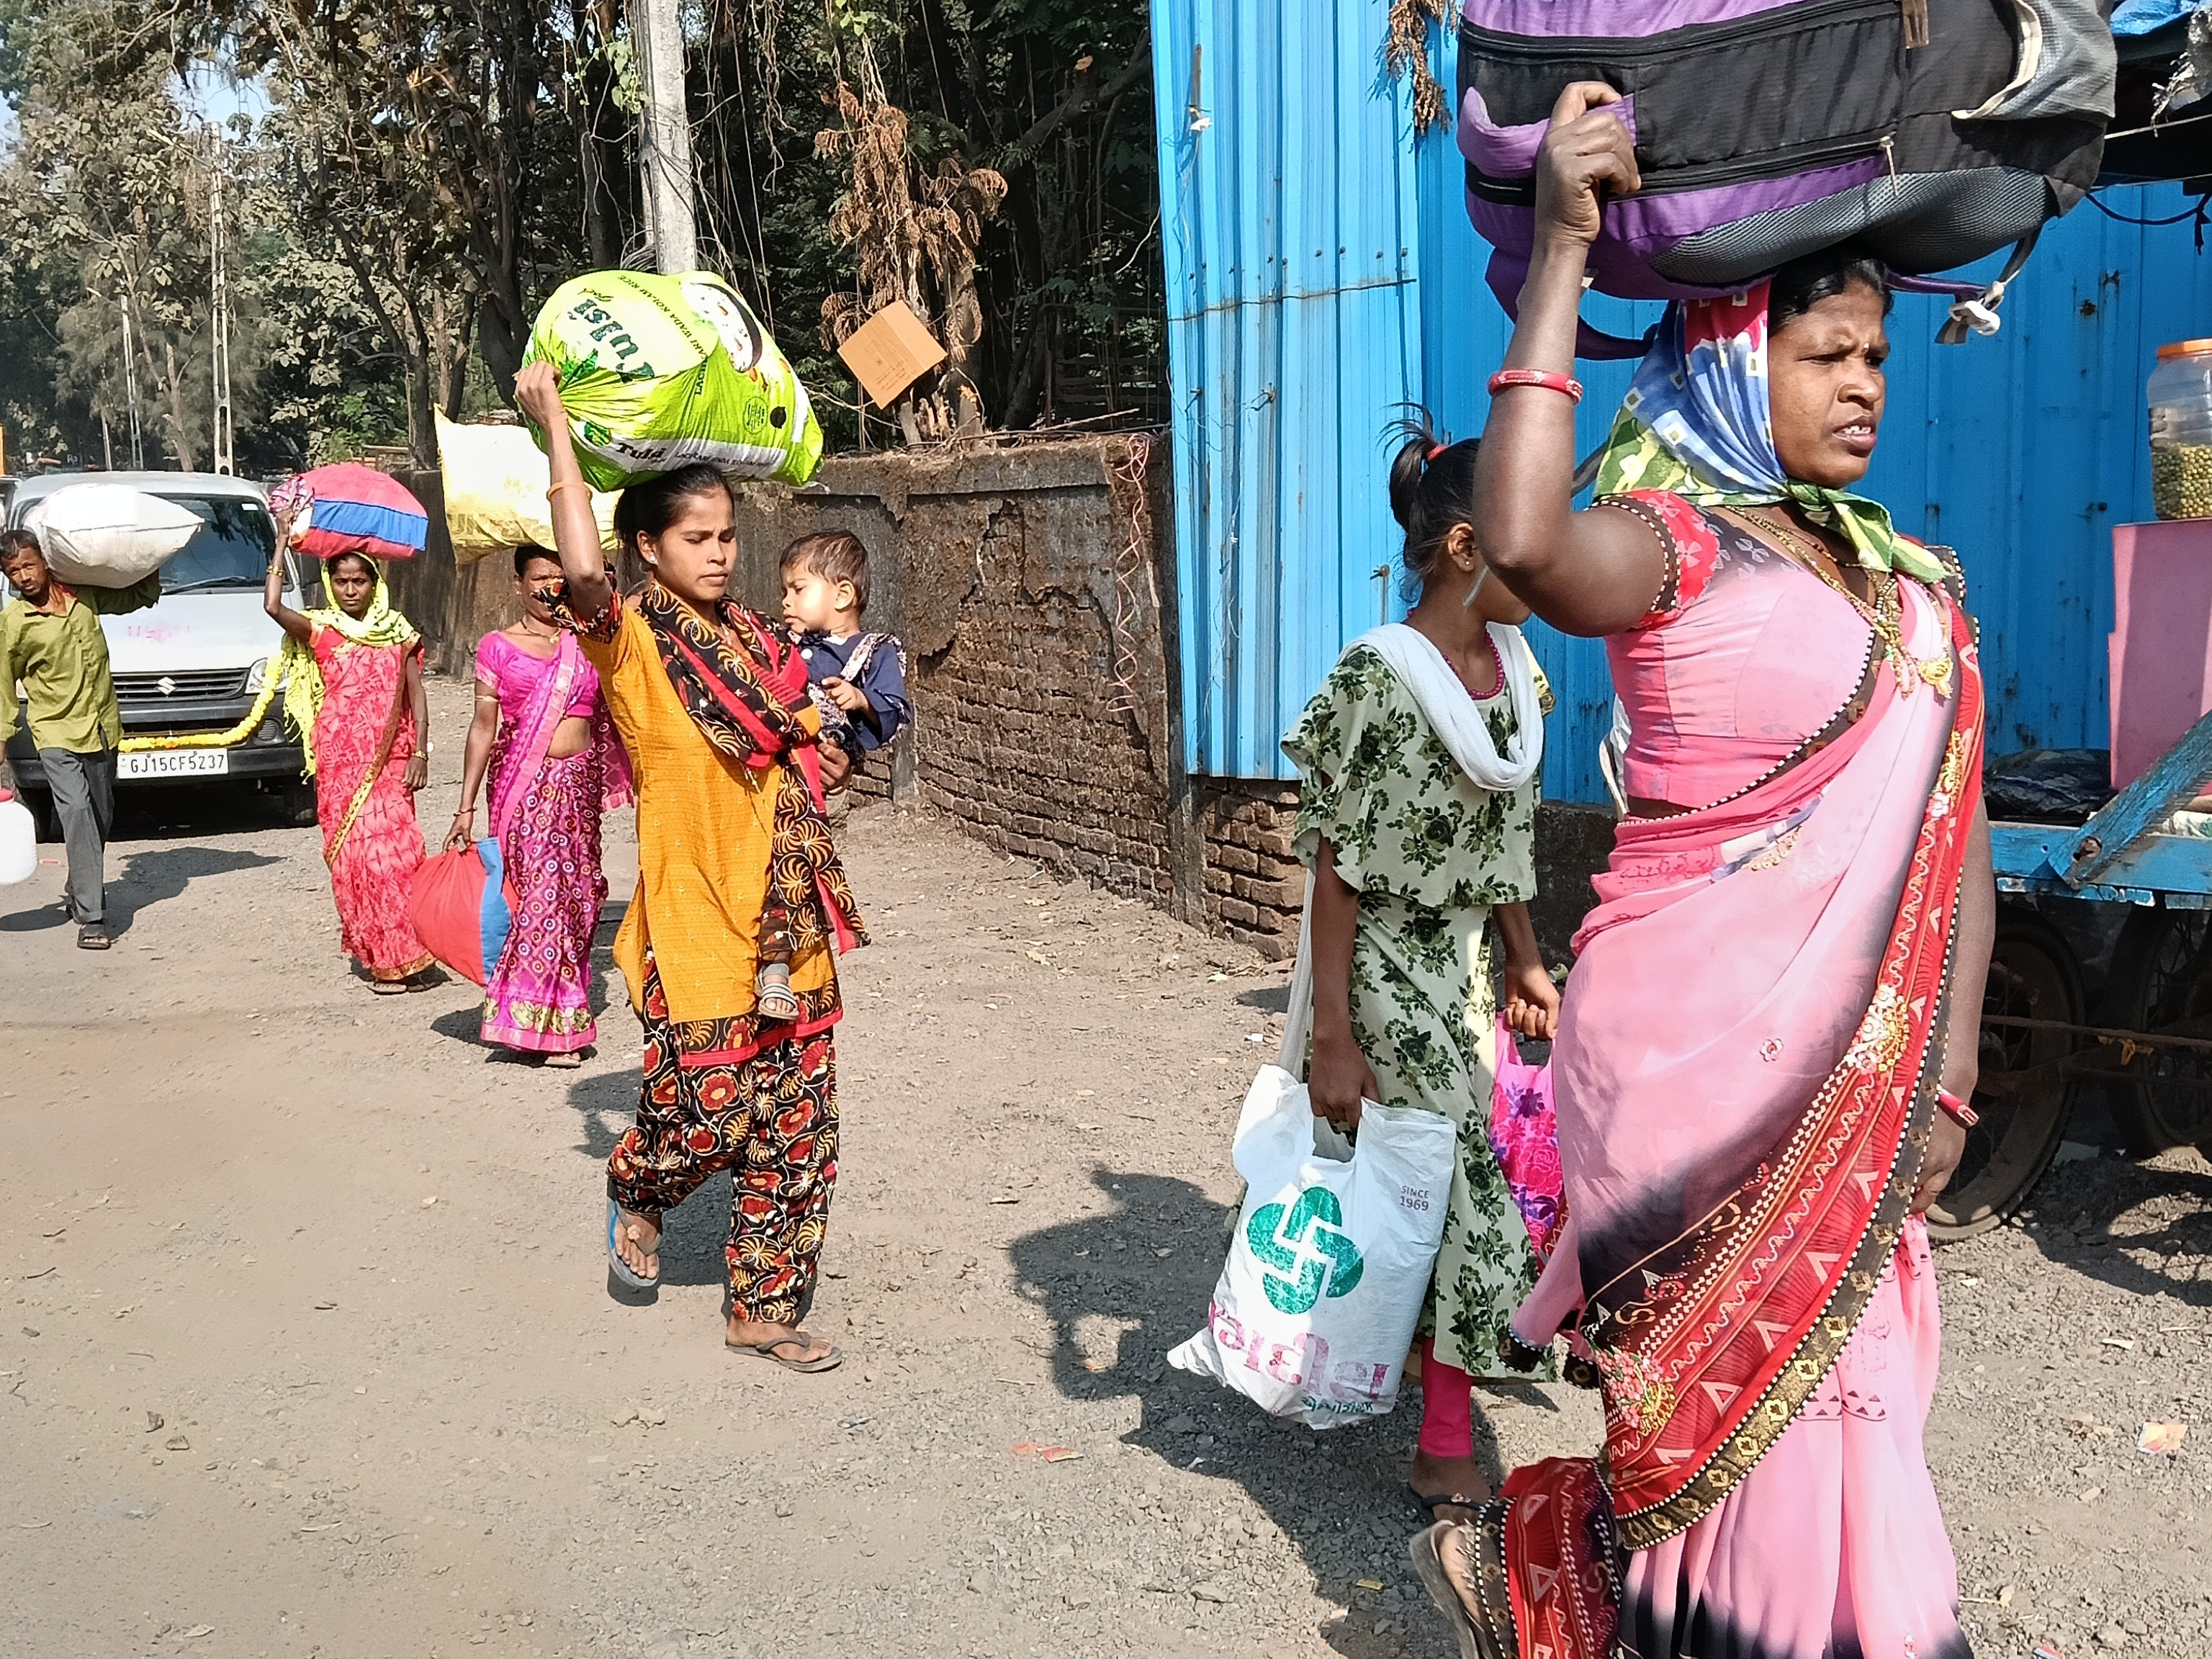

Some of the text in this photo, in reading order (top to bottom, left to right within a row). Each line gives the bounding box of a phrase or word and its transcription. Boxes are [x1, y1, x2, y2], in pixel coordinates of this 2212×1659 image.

[617, 275, 640, 289] RICE
[639, 289, 670, 313] KOLAM
[670, 313, 692, 338] WADA
[567, 298, 655, 384] Tulsi
[131, 754, 225, 773] GJ15CF5237
[1401, 1185, 1429, 1199] SINCE
[1399, 1195, 1429, 1211] 1969
